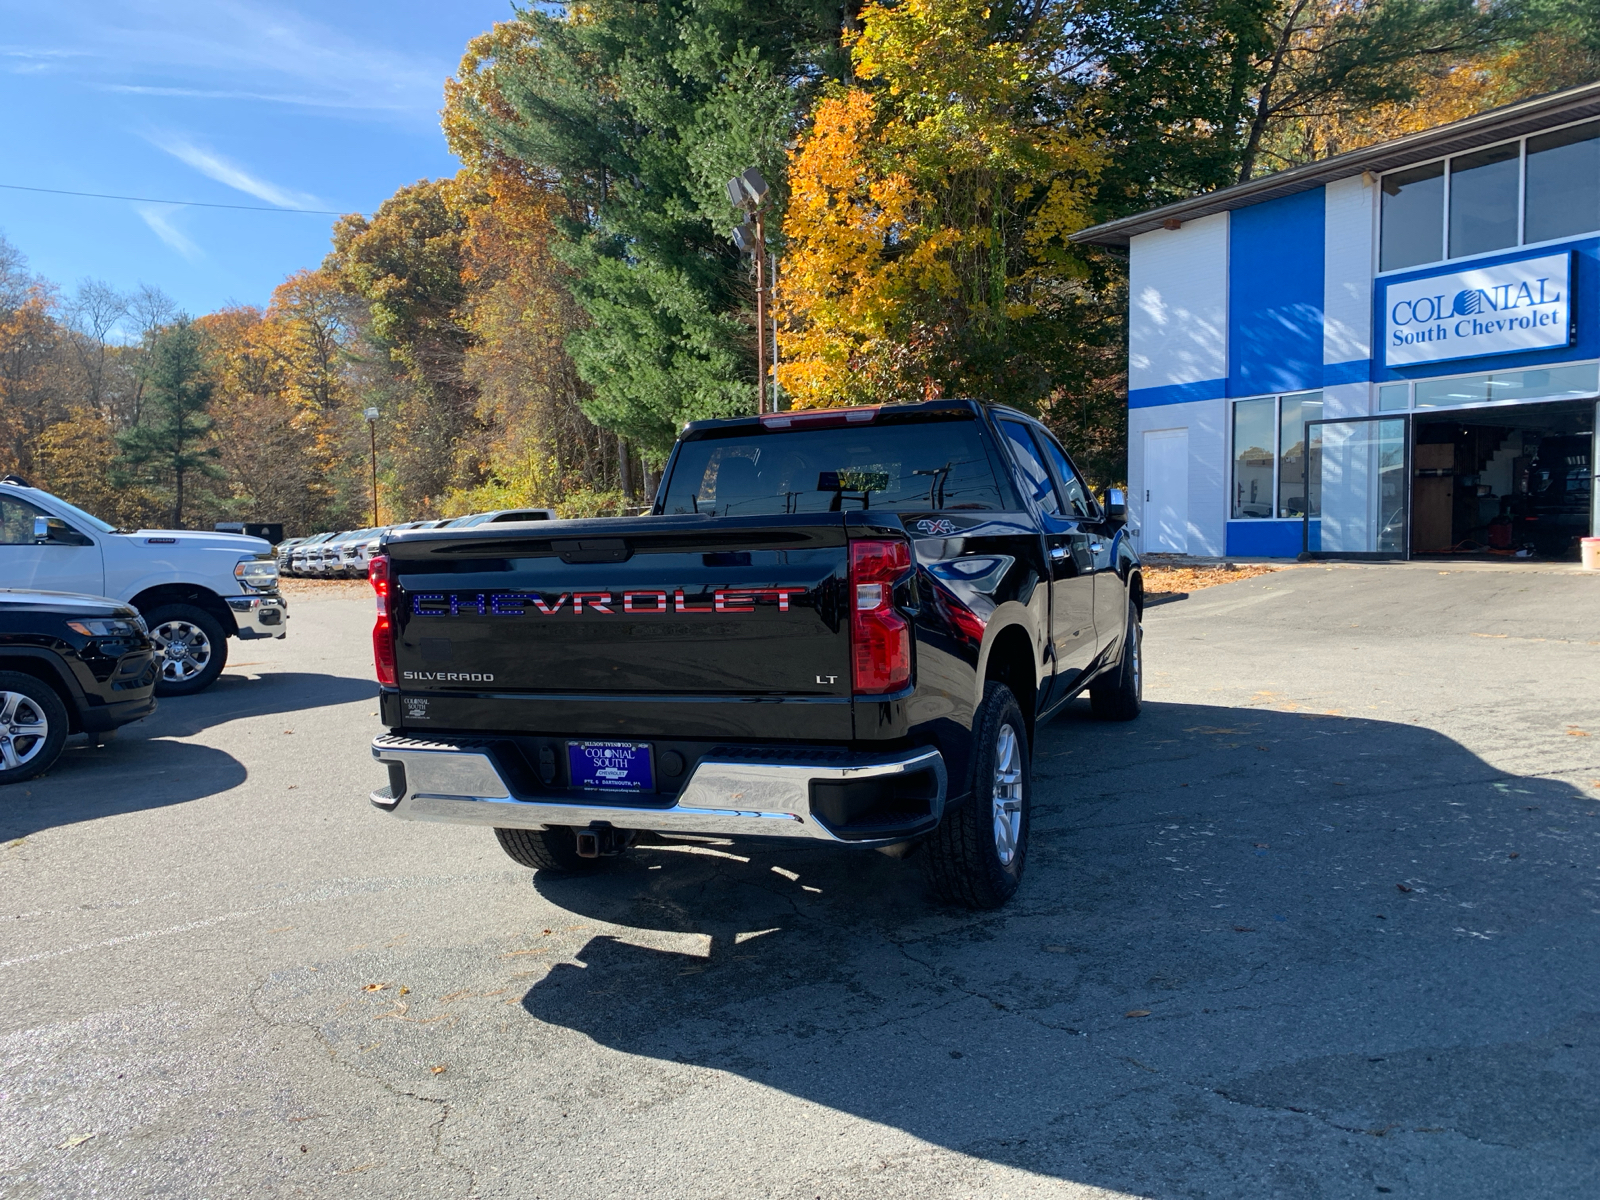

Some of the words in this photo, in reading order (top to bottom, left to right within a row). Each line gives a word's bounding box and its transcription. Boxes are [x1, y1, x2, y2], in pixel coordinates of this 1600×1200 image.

[1392, 278, 1560, 326] COLONIAL
[1393, 324, 1447, 346] South
[1455, 308, 1560, 338] Chevrolet
[413, 586, 807, 617] CHEVROLET
[403, 671, 495, 682] SILVERADO
[815, 675, 839, 684] LT
[585, 748, 636, 760] COLONIAL
[593, 758, 628, 768] SOUTH
